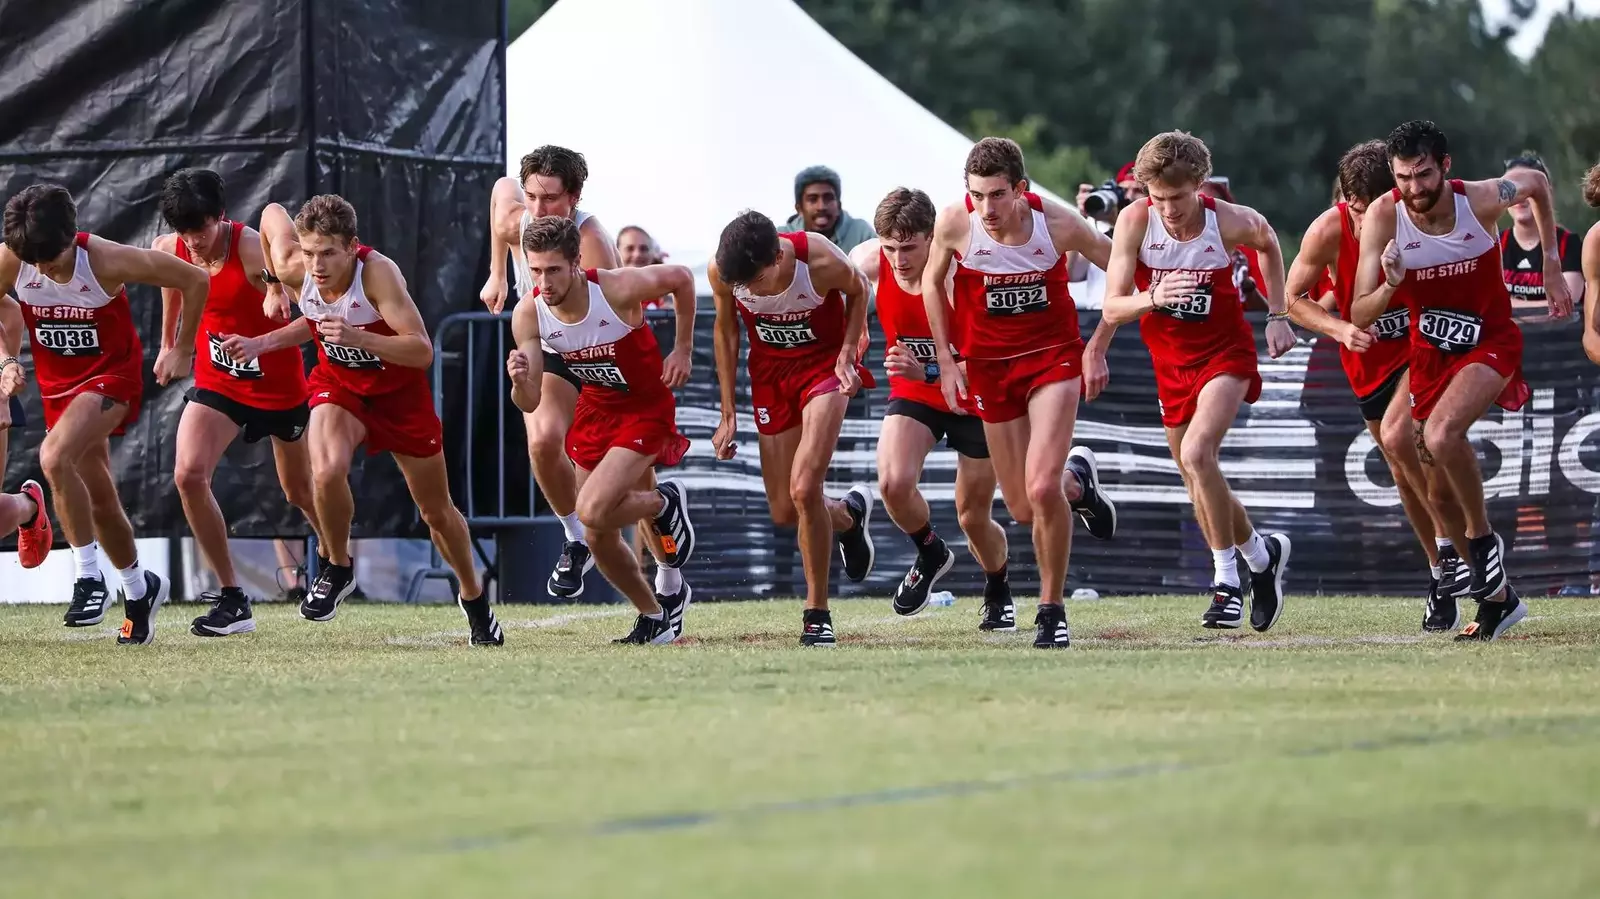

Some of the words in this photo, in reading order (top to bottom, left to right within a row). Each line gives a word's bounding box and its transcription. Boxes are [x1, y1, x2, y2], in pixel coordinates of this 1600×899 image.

[1403, 241, 1421, 250] ACC
[1416, 269, 1435, 281] NC
[1438, 259, 1478, 278] STATE
[983, 274, 1002, 286] NC
[1004, 272, 1044, 285] STATE
[990, 288, 1043, 308] 3032
[32, 305, 50, 318] NC
[53, 306, 95, 320] STATE
[771, 310, 812, 322] STATE
[546, 330, 563, 340] ACC
[760, 328, 811, 343] 3034
[1422, 314, 1476, 344] 3029
[39, 330, 95, 348] 3038
[580, 343, 616, 359] STATE
[572, 368, 623, 382] 3035
